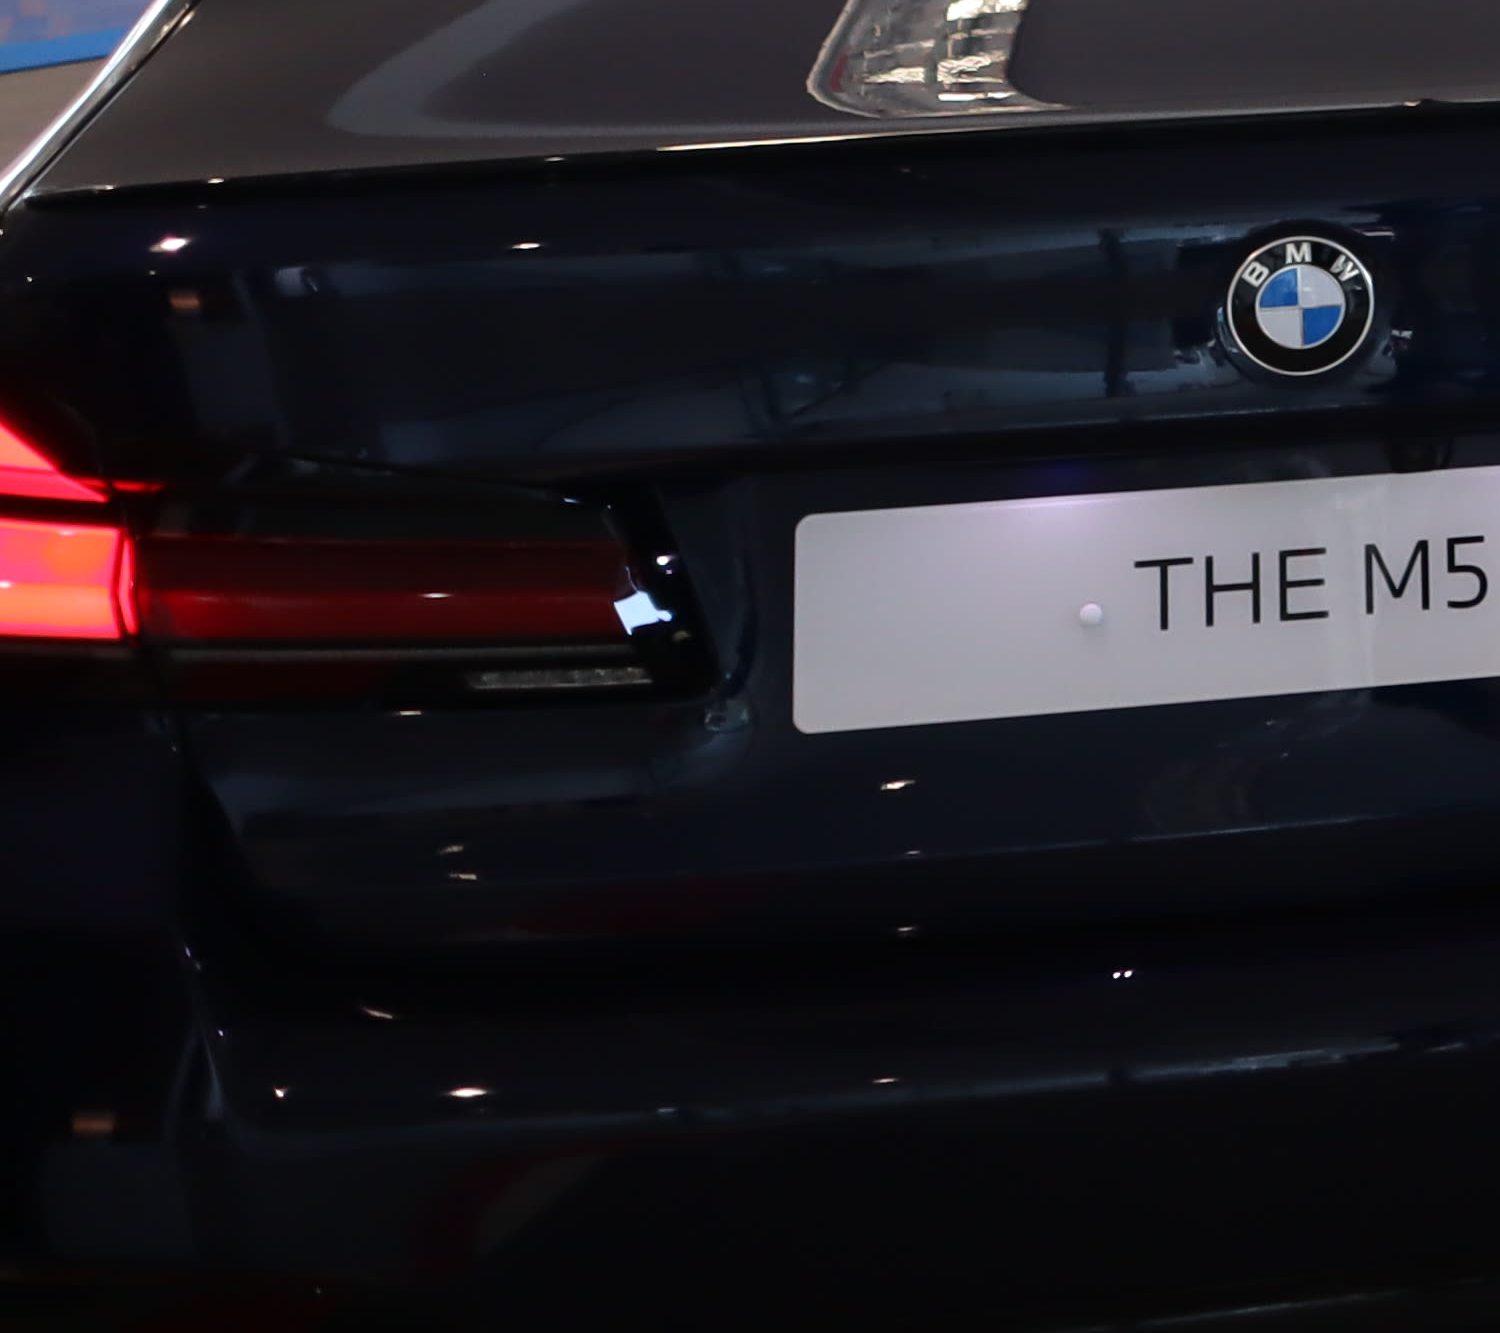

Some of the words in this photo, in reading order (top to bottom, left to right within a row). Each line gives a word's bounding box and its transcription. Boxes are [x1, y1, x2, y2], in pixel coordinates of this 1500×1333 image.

[1242, 242, 1360, 287] BMW
[1134, 546, 1329, 631] THE
[1364, 535, 1489, 615] M5
